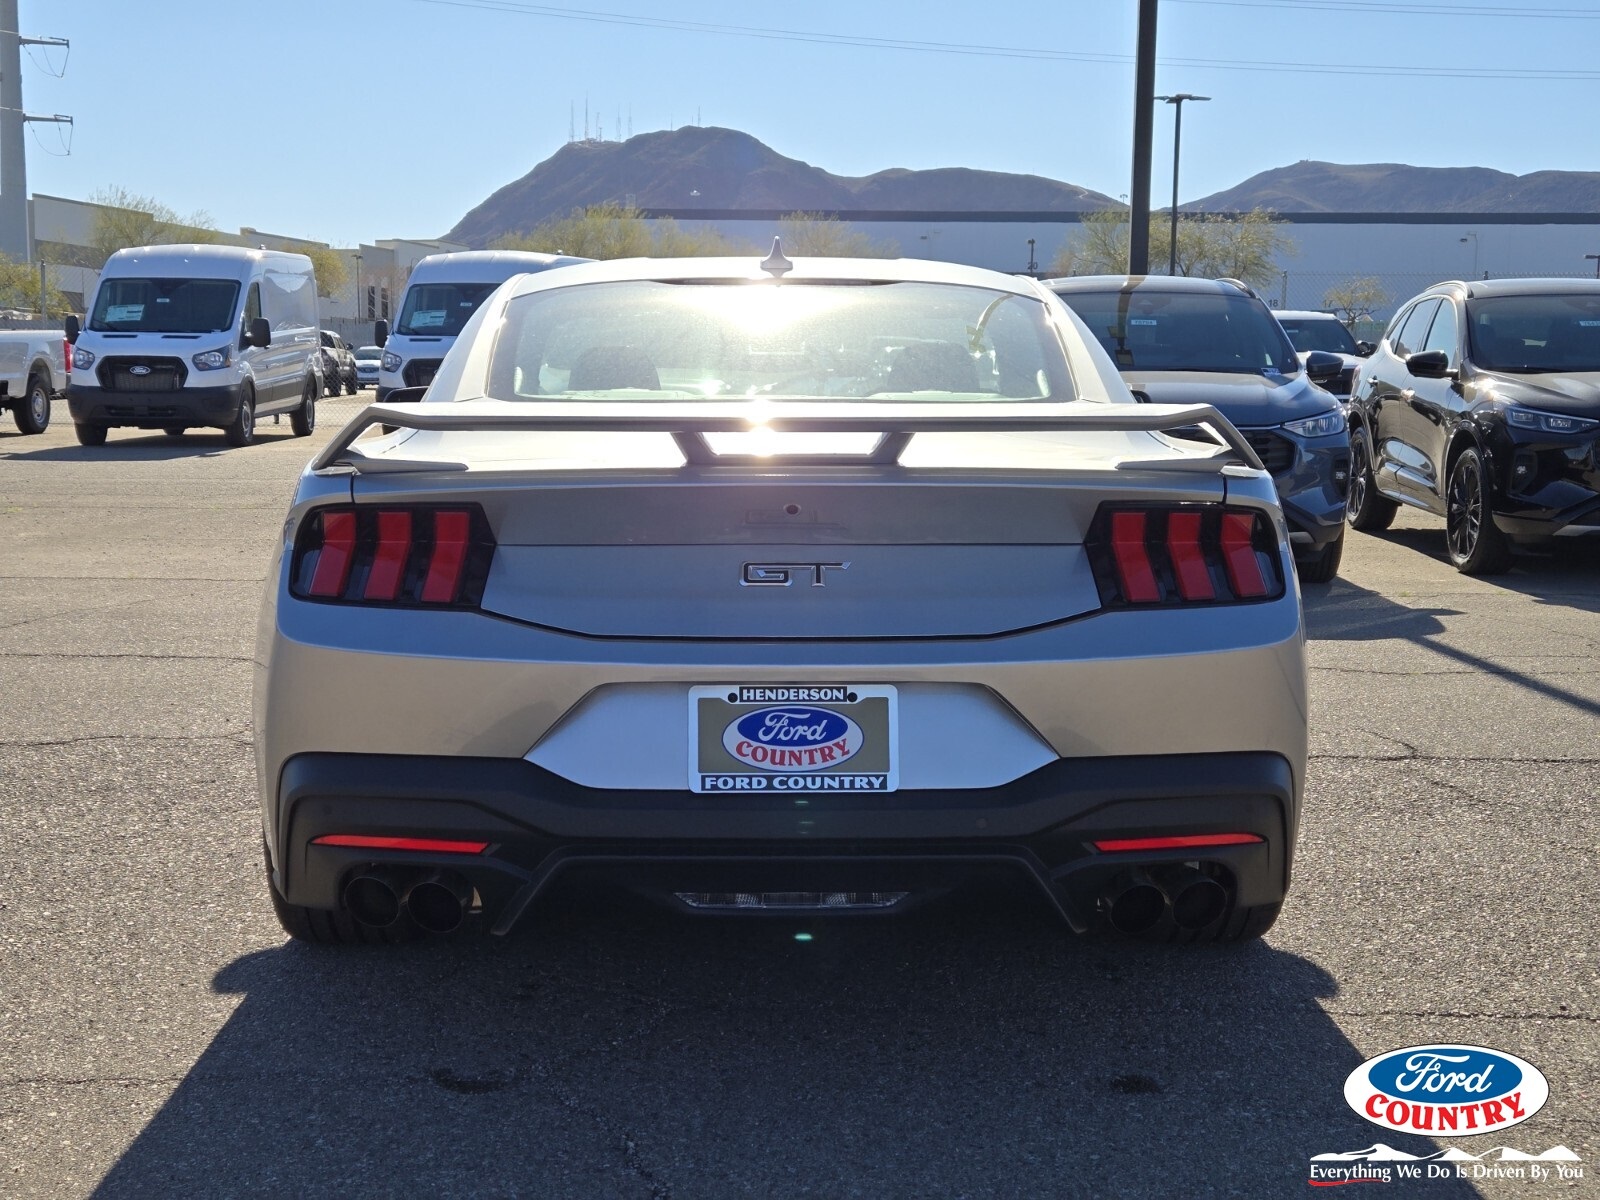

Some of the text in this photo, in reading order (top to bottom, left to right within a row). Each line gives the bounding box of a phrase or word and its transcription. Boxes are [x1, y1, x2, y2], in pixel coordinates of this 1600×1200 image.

[1268, 299, 1279, 308] 18
[739, 561, 851, 587] GT
[742, 688, 844, 701] HENDERSON
[757, 712, 828, 741] Ford
[735, 738, 850, 767] COUNTRY
[704, 776, 885, 790] FORD COUNTRY
